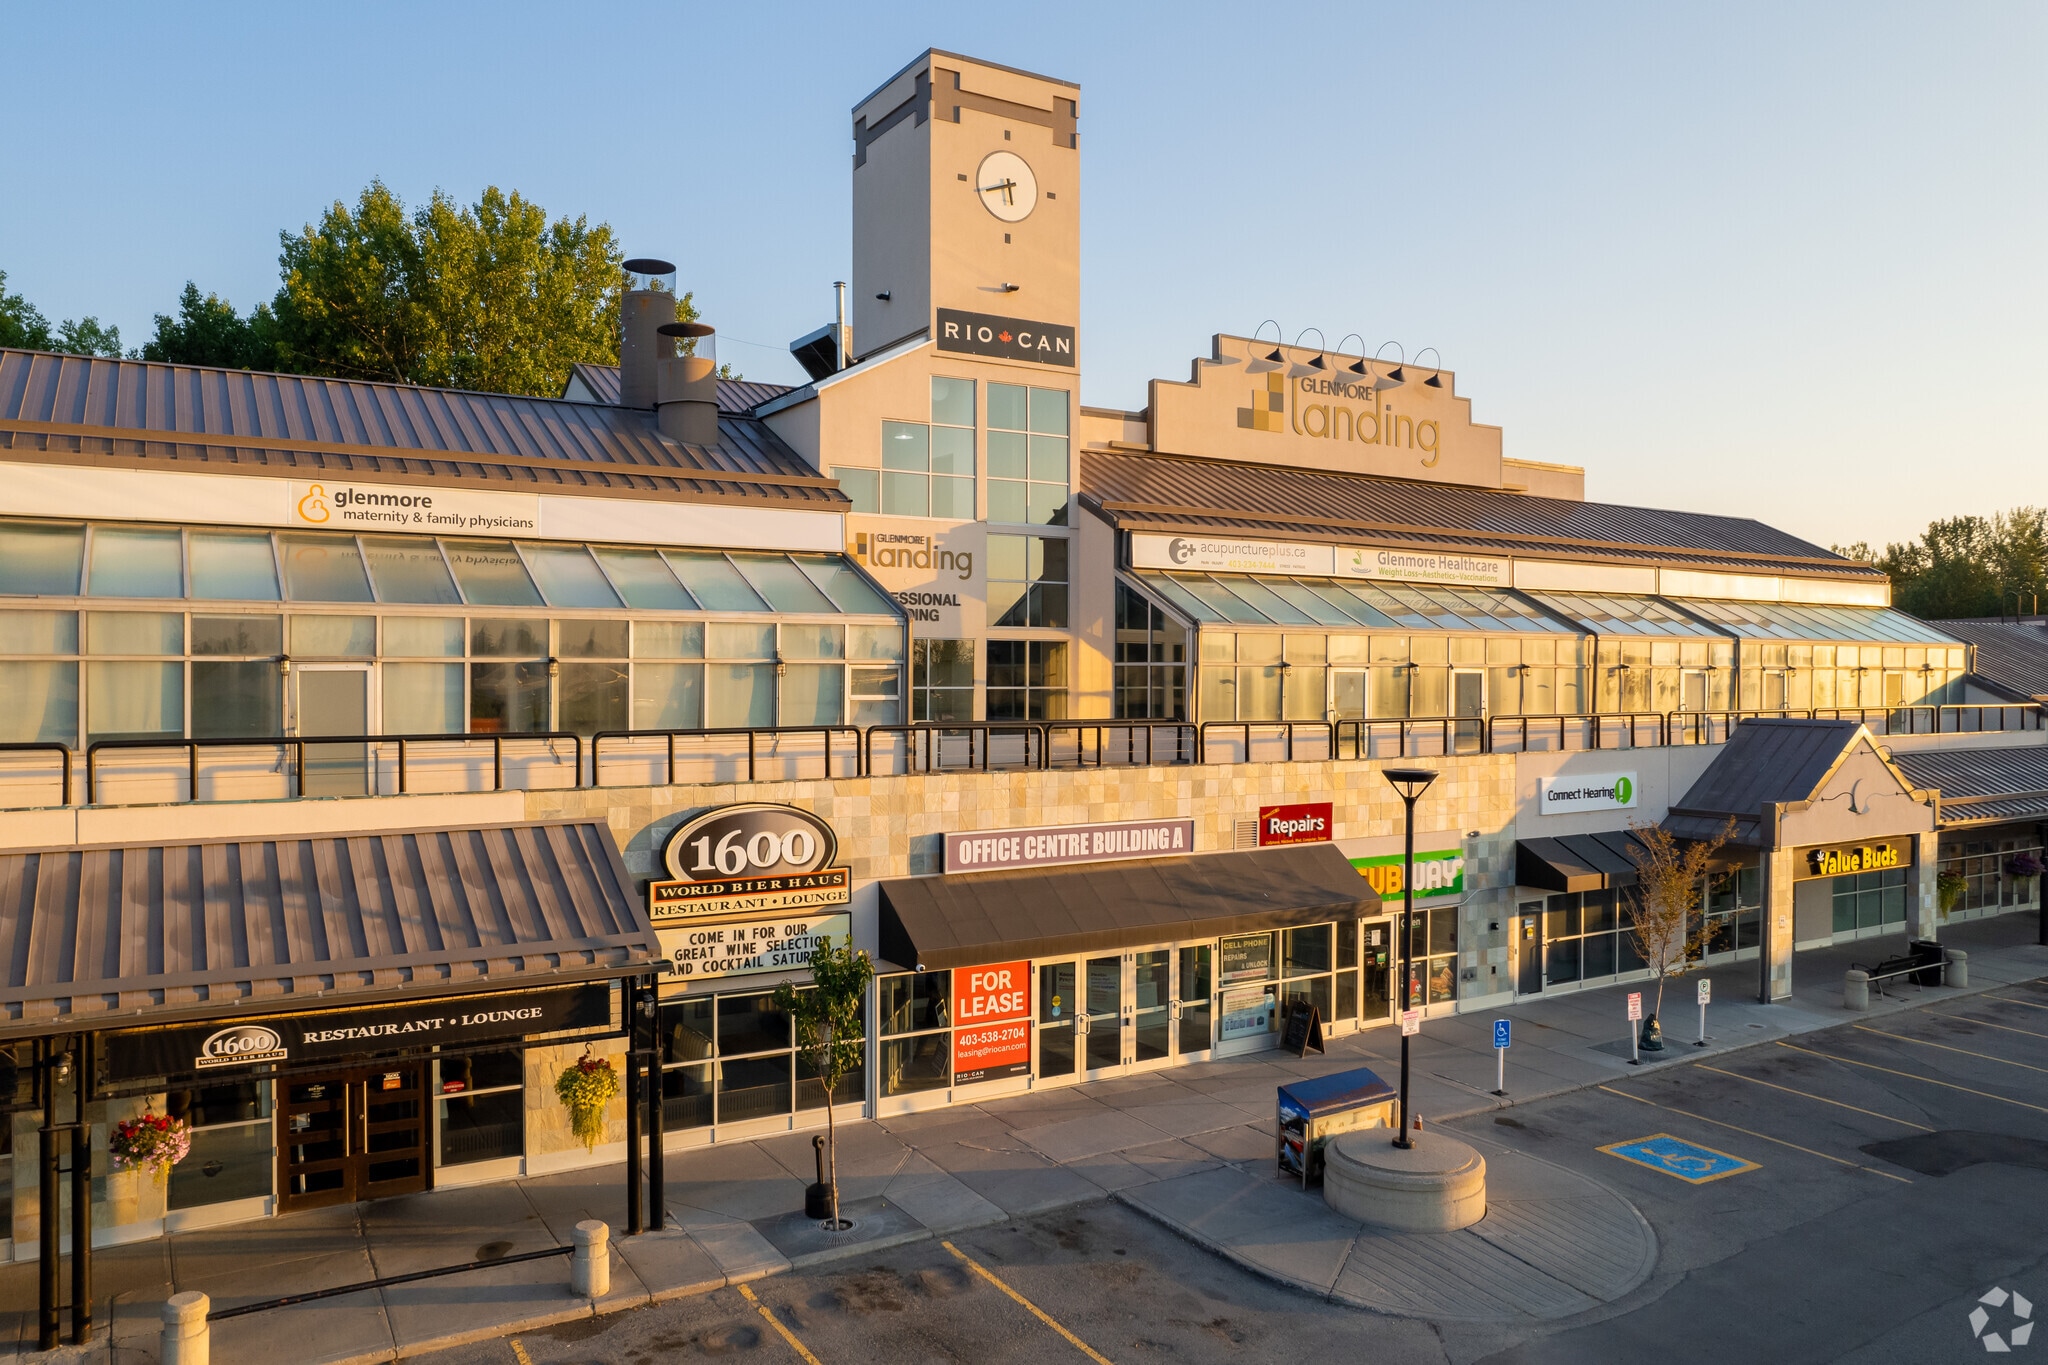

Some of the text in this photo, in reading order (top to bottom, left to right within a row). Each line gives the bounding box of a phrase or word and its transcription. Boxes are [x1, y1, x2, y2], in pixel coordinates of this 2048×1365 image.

[945, 321, 1070, 354] RIO CAN
[1301, 377, 1372, 401] GLENMORE
[1292, 376, 1440, 468] landing
[334, 488, 433, 508] glenmore
[343, 510, 534, 529] maternity & family physicians
[876, 534, 925, 544] GLENMORE
[870, 533, 973, 580] landing
[1201, 543, 1306, 559] acupunctureplus.ca
[1377, 551, 1499, 573] Glenmore Healthcare
[1378, 567, 1403, 578] Weight
[1548, 787, 1615, 801] Connect Hearing
[1270, 814, 1325, 837] Repairs
[690, 829, 815, 875] 1600
[959, 827, 1184, 865] OFFICE CENTRE BUILDING A
[1819, 844, 1898, 875] Value Buds
[660, 874, 842, 897] WORLD BIER HAUS
[654, 891, 847, 916] RESTAURANT LOUNGE
[689, 924, 807, 945] COME IN FOR OUR
[1224, 939, 1268, 950] CELL PHONE
[675, 936, 826, 961] GREAT WINE SELECTIO
[1224, 953, 1248, 961] REPAIRS
[669, 963, 693, 977] AND
[702, 956, 764, 973] COCKTAIL
[1246, 960, 1268, 969] UNLOCK
[971, 970, 1012, 993] FOR
[960, 992, 1024, 1018] LEASE
[304, 1007, 543, 1044] RESTAURANT LOUNGE
[959, 1027, 1025, 1046] 403-538-2704
[213, 1035, 270, 1054] 1600
[958, 1042, 1027, 1058] leasing@riocan.com
